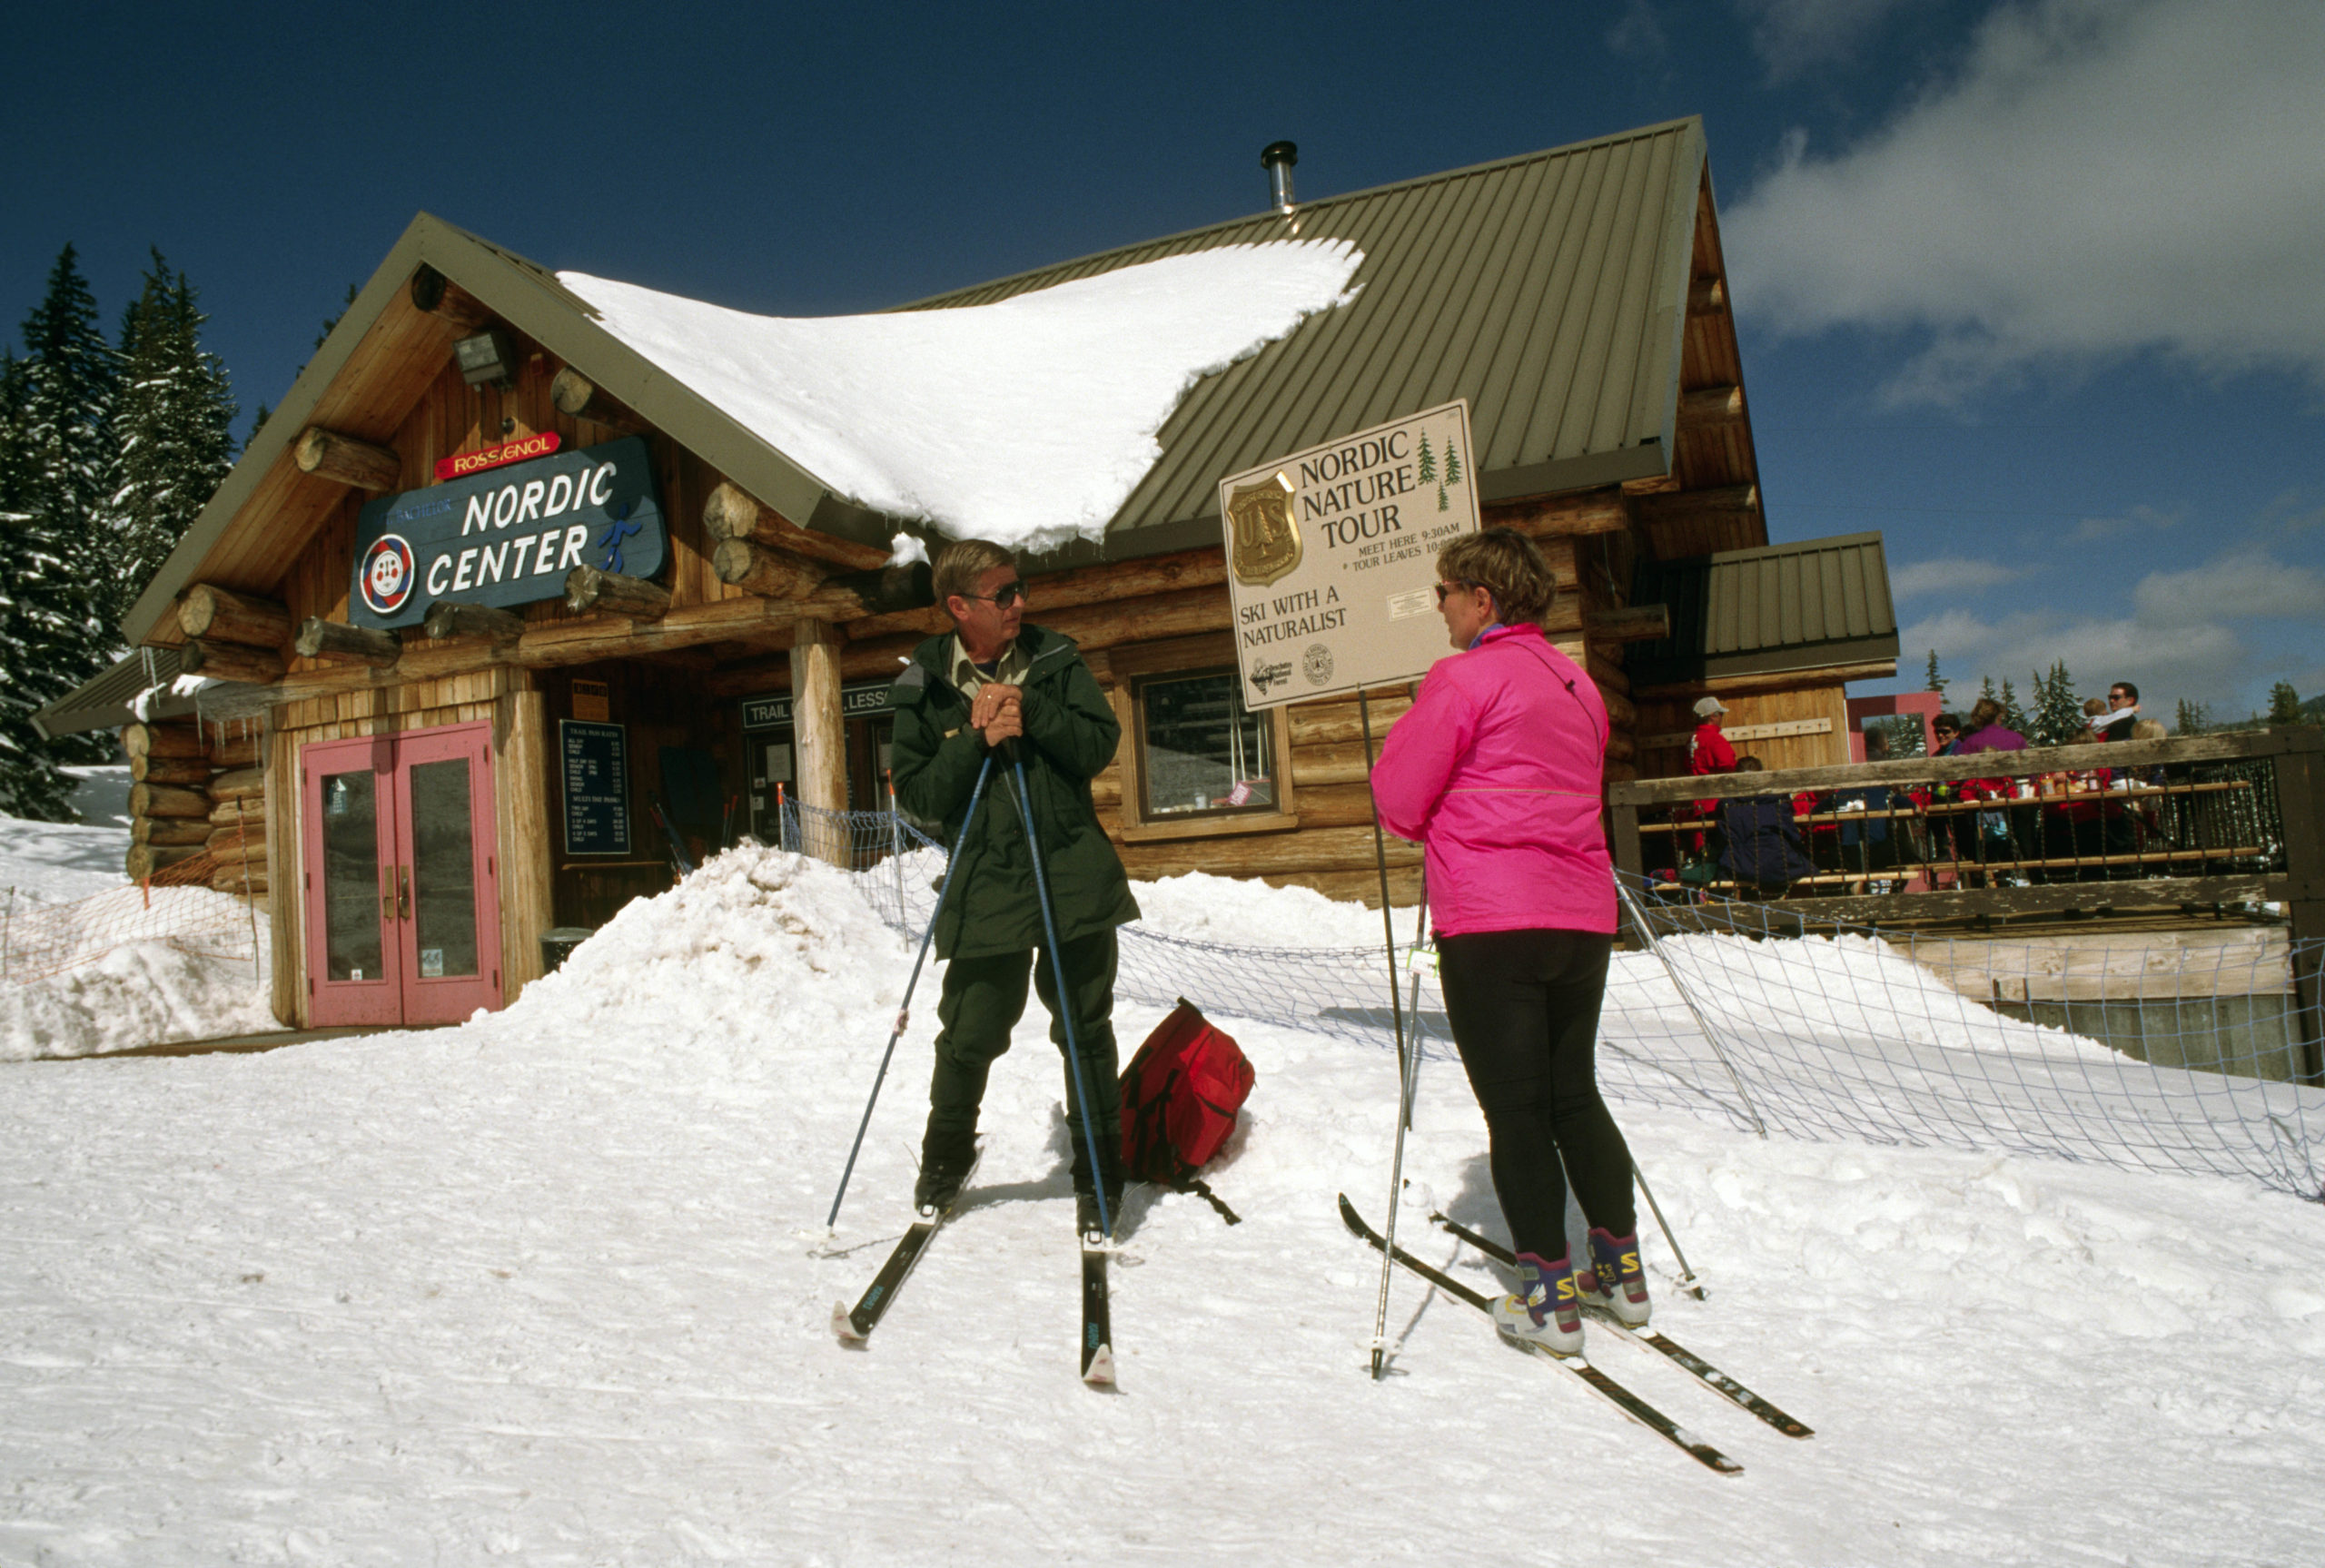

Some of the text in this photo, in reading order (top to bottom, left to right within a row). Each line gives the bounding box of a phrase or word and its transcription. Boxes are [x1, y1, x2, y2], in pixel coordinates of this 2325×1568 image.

[454, 437, 549, 473] ROSSIGNOL
[1300, 430, 1410, 488] NORDIC
[461, 462, 617, 536] NORDIC
[1301, 465, 1416, 521] NATURE
[1321, 504, 1401, 549] TOUR
[1359, 523, 1460, 557] MEET HERE 9:30AM
[427, 525, 588, 597] CENTER
[1352, 557, 1380, 571] TOUR
[1383, 547, 1421, 564] LEAVES
[1241, 585, 1340, 626] SKI WITH A
[1242, 607, 1347, 648] NATURALIST
[750, 704, 789, 722] TRAIL
